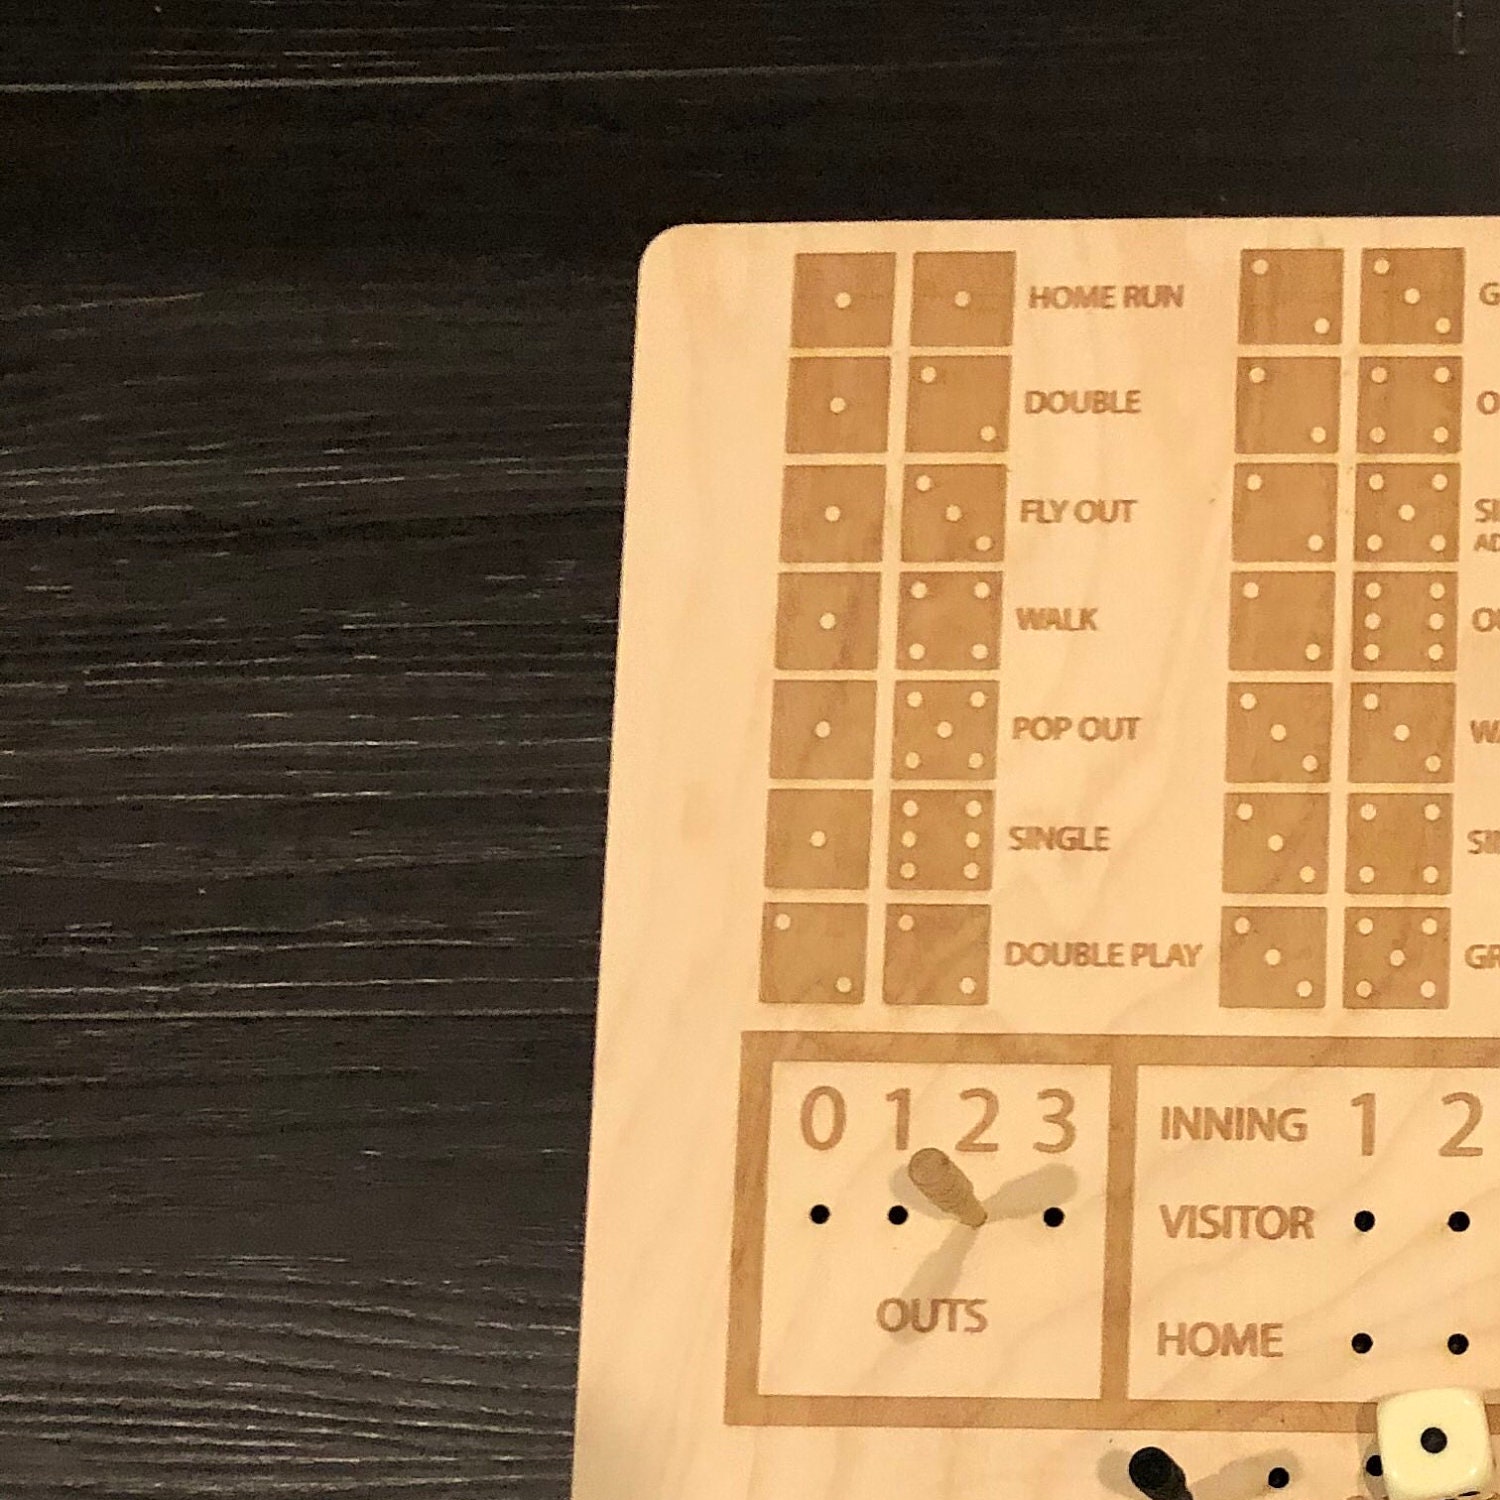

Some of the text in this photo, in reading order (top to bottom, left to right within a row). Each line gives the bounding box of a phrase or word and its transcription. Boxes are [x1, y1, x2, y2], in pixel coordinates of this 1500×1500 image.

[1029, 284, 1184, 309] HOME RUN
[1025, 390, 1141, 414] DOUBLE
[1020, 499, 1137, 524] FLY OUT
[1017, 608, 1099, 631] WALK
[1013, 717, 1140, 740] POP OUT
[1008, 827, 1110, 852] SINGLE
[1005, 942, 1202, 967] DOUBLE PLAY
[800, 1086, 1076, 1153] 0 1 2 3
[1161, 1106, 1308, 1142] INNING
[1350, 1093, 1376, 1157] 1
[1439, 1092, 1484, 1157] 2
[1161, 1204, 1314, 1240] VISITOR
[876, 1298, 987, 1334] OUTS
[1157, 1322, 1284, 1357] HOME
